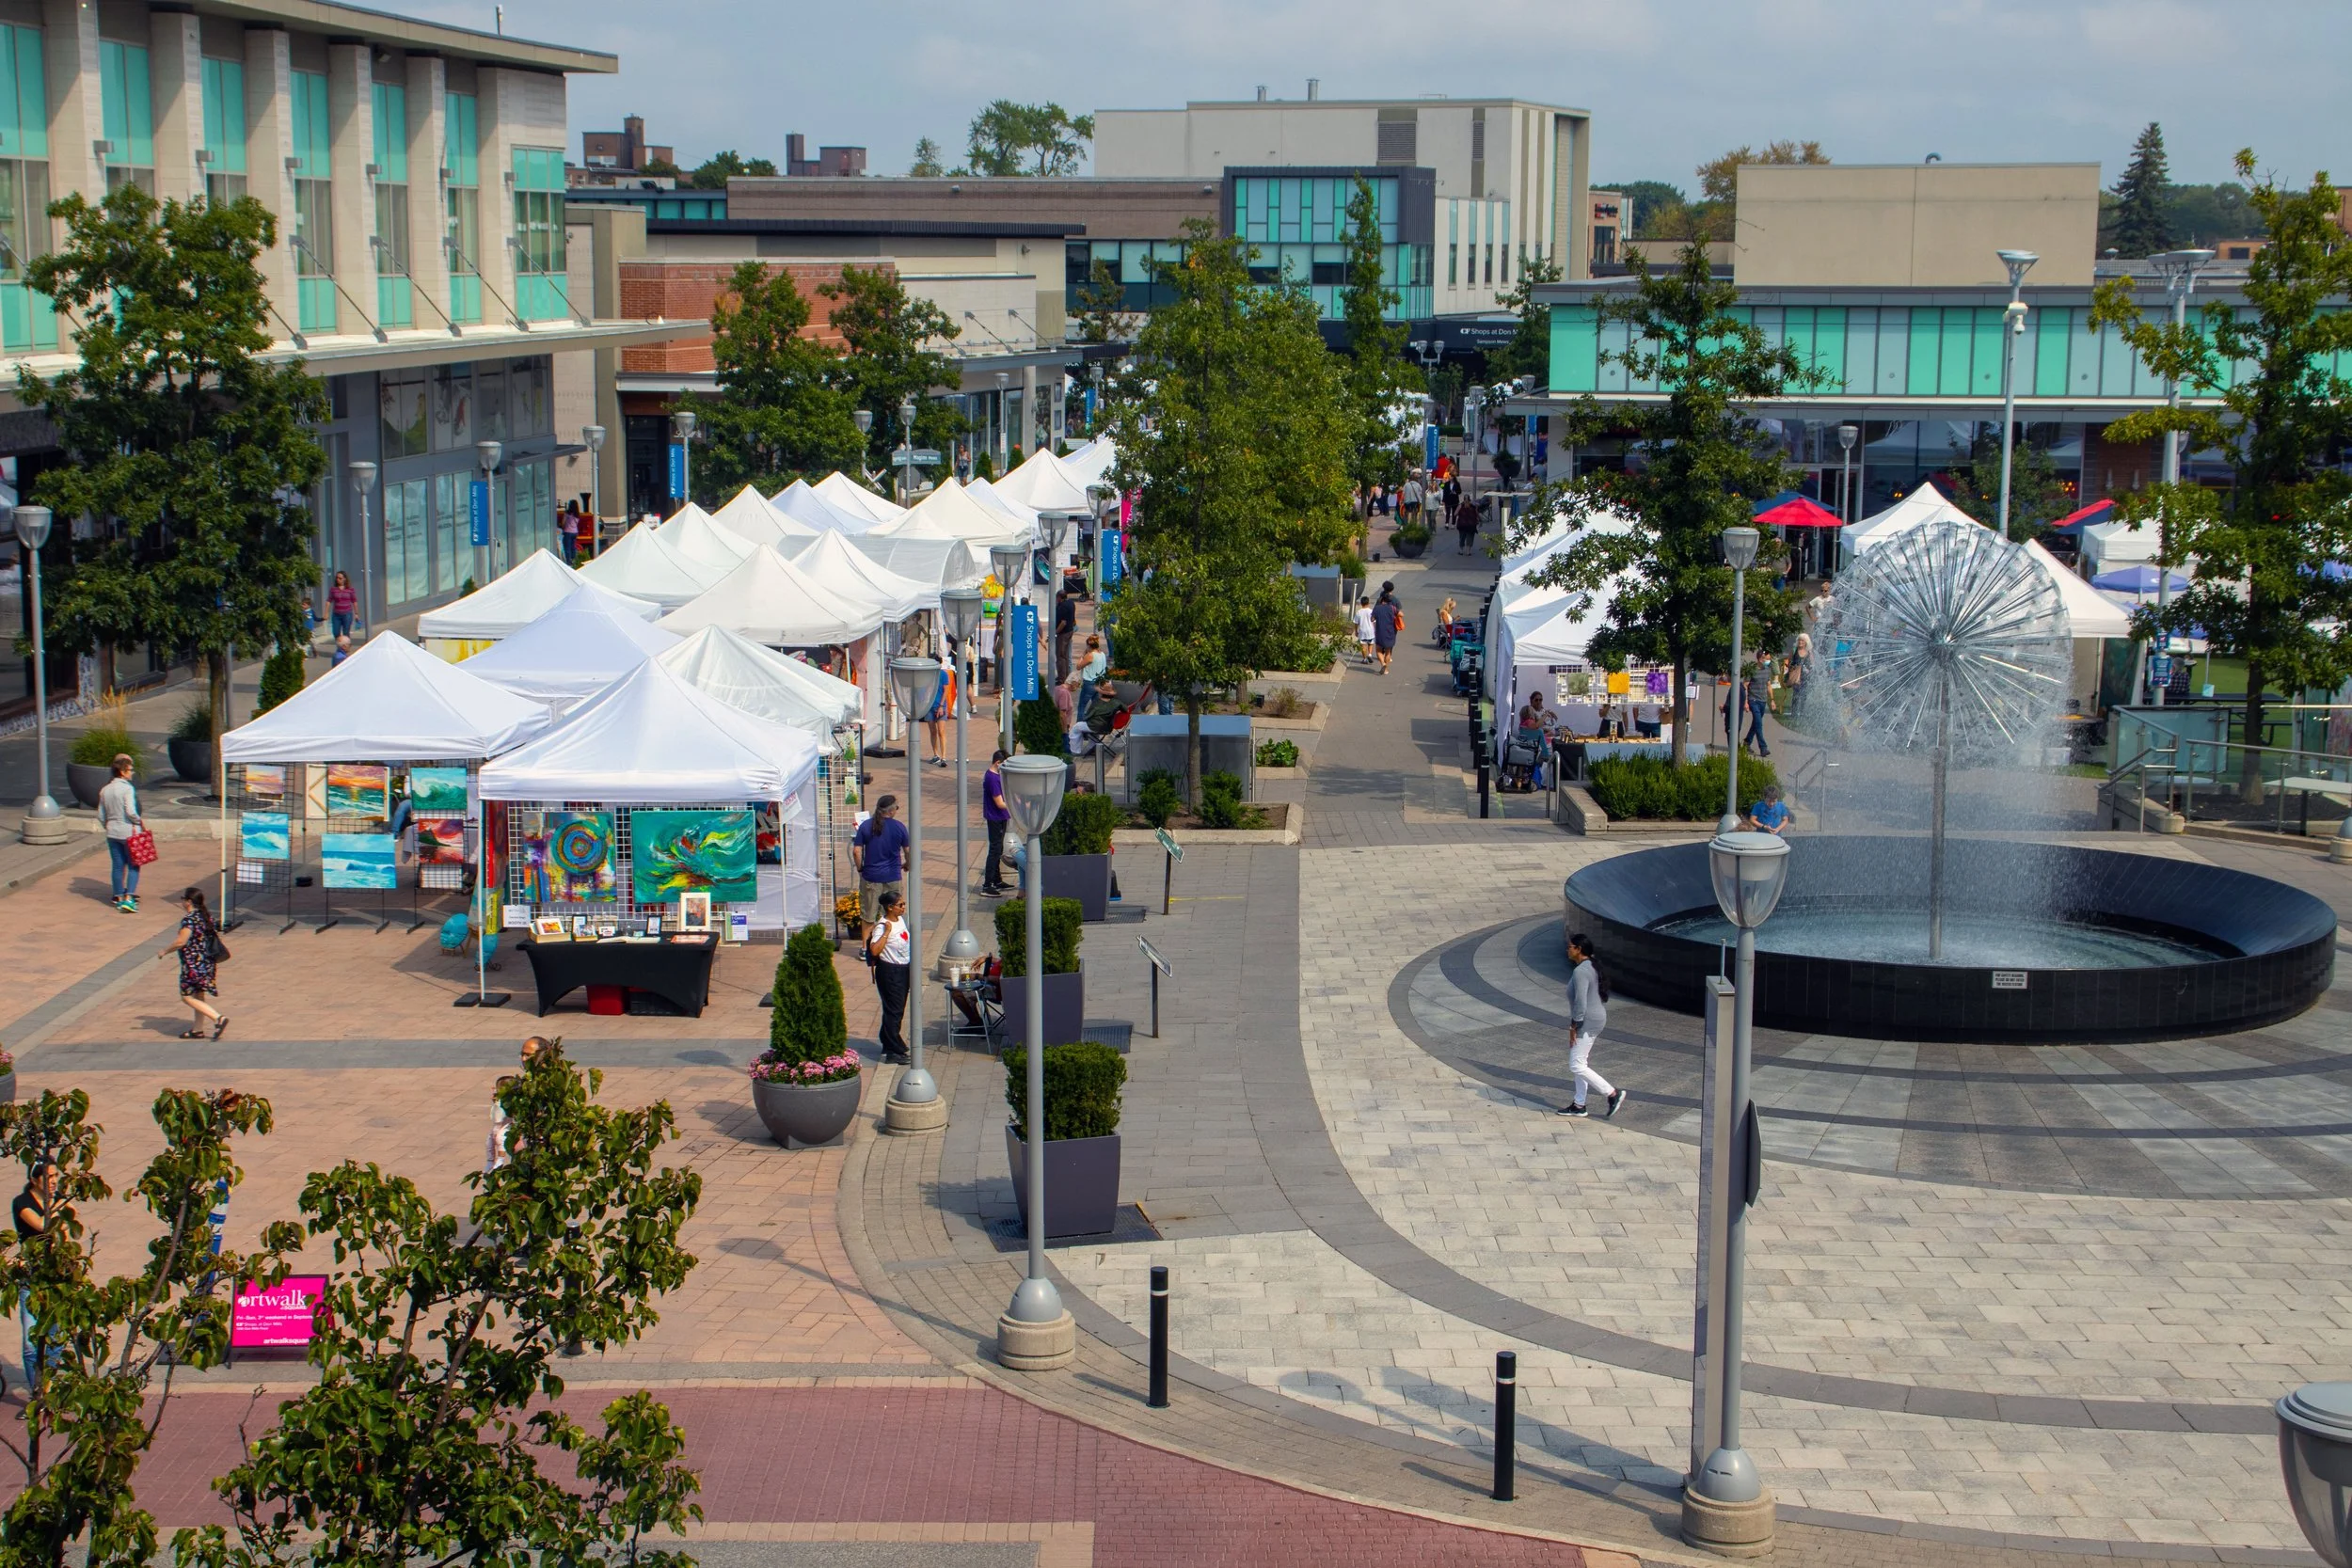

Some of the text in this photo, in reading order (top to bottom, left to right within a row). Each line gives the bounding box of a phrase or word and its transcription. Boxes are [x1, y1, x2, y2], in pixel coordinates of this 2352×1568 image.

[1026, 651, 1033, 659] at
[1026, 660, 1035, 676] Don
[1026, 677, 1035, 695] Mills
